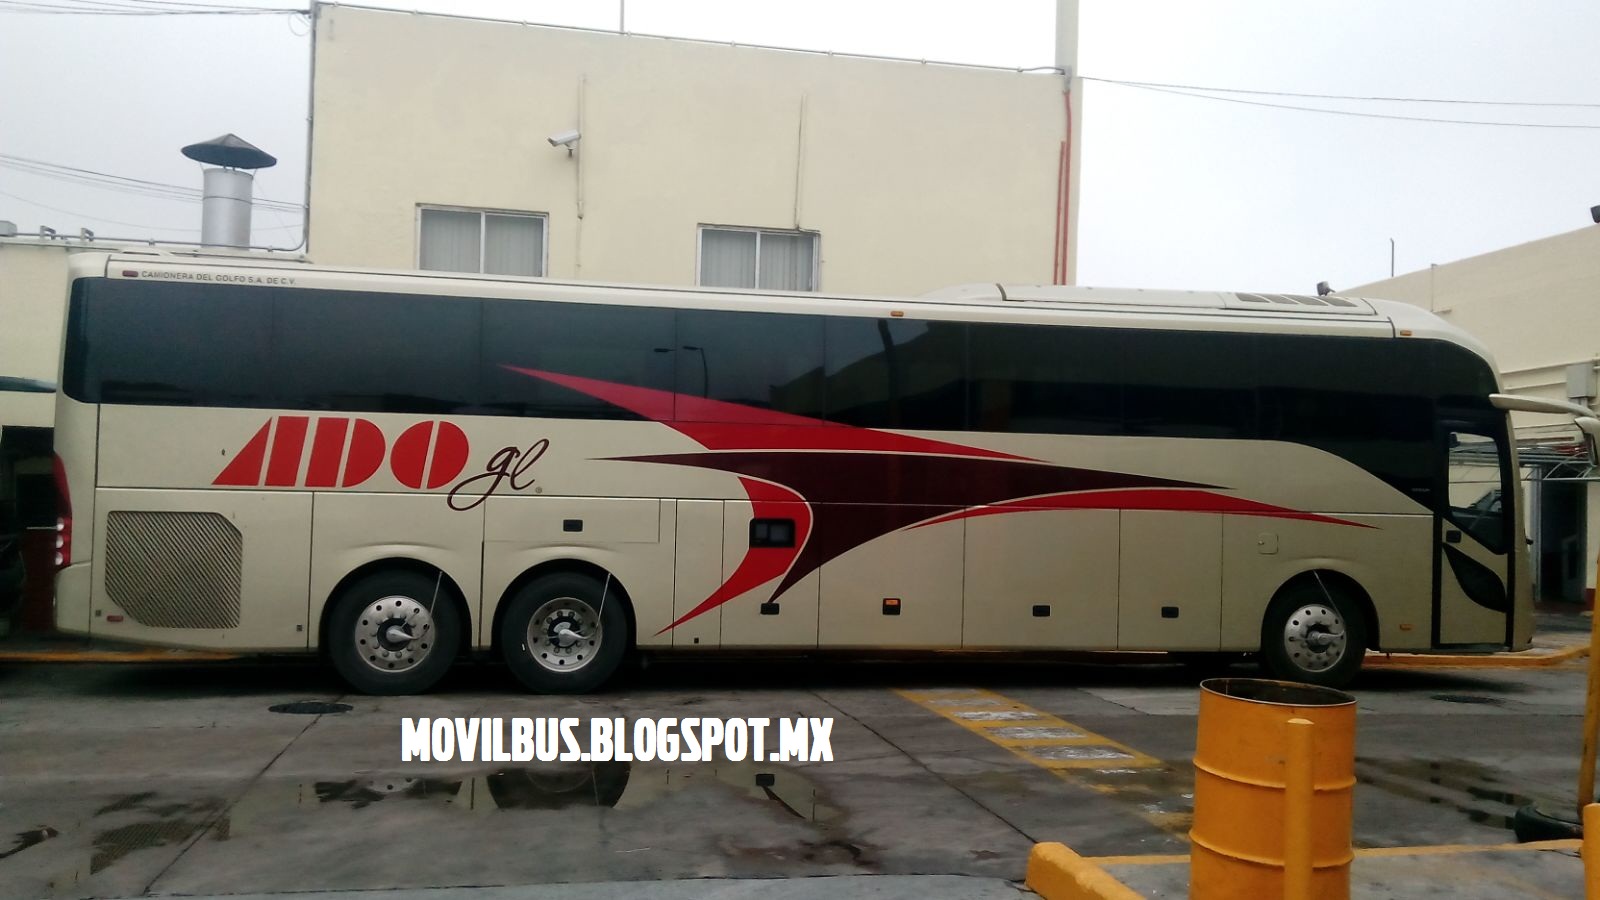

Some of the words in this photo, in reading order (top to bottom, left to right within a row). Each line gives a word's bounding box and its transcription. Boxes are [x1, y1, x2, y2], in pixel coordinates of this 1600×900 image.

[141, 270, 194, 280] CAMIONERA
[196, 273, 213, 281] DEL
[215, 274, 246, 283] GOLFO
[266, 276, 279, 284] DE
[211, 416, 469, 489] ADO
[447, 438, 549, 511] gl
